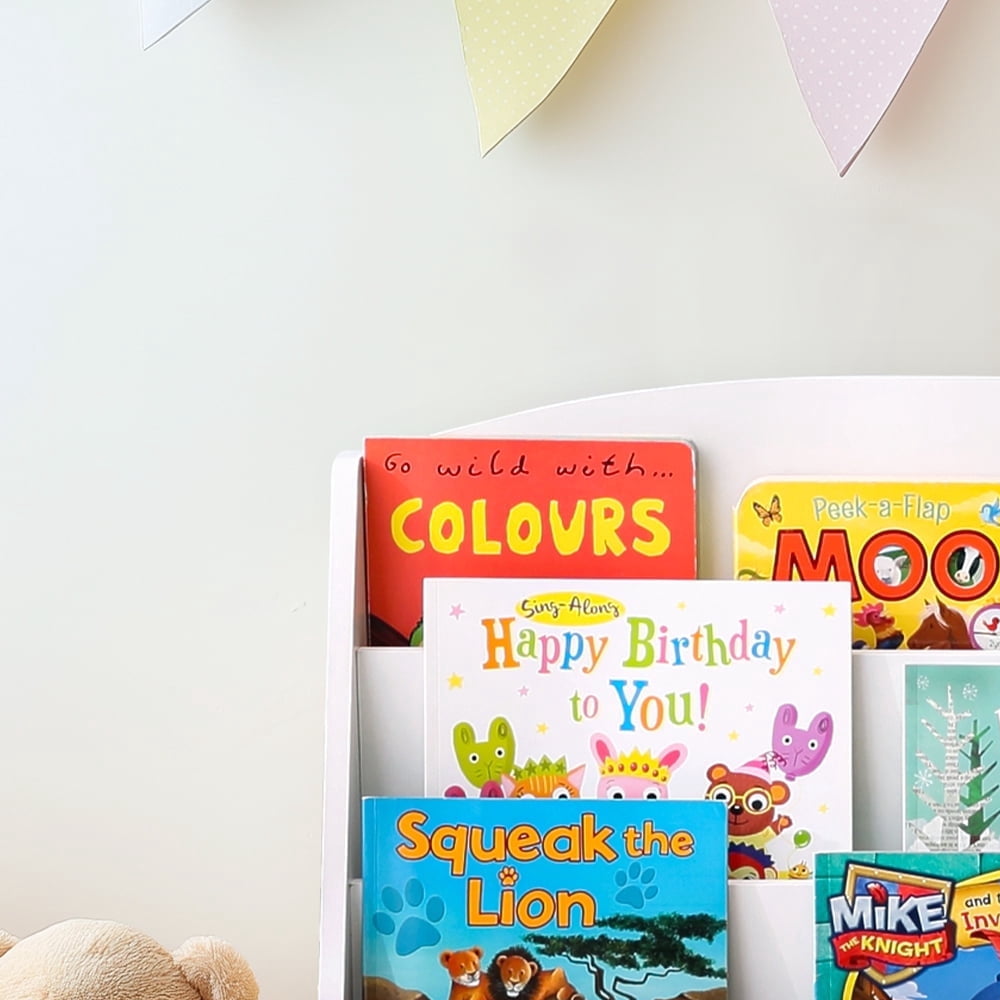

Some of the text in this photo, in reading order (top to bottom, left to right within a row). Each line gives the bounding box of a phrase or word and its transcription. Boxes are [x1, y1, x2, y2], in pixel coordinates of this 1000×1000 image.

[384, 450, 674, 477] Go wild with...
[390, 497, 671, 556] COLOURS
[813, 494, 950, 525] Peek-a-Flap
[772, 529, 1000, 601] MOO
[521, 597, 620, 618] Sing-Along
[481, 616, 797, 676] Happy Birthday
[569, 679, 710, 732] to You!
[396, 810, 695, 876] Squeak the
[467, 867, 596, 928] Lion
[965, 893, 991, 908] and
[839, 935, 944, 958] THE KNIGHT
